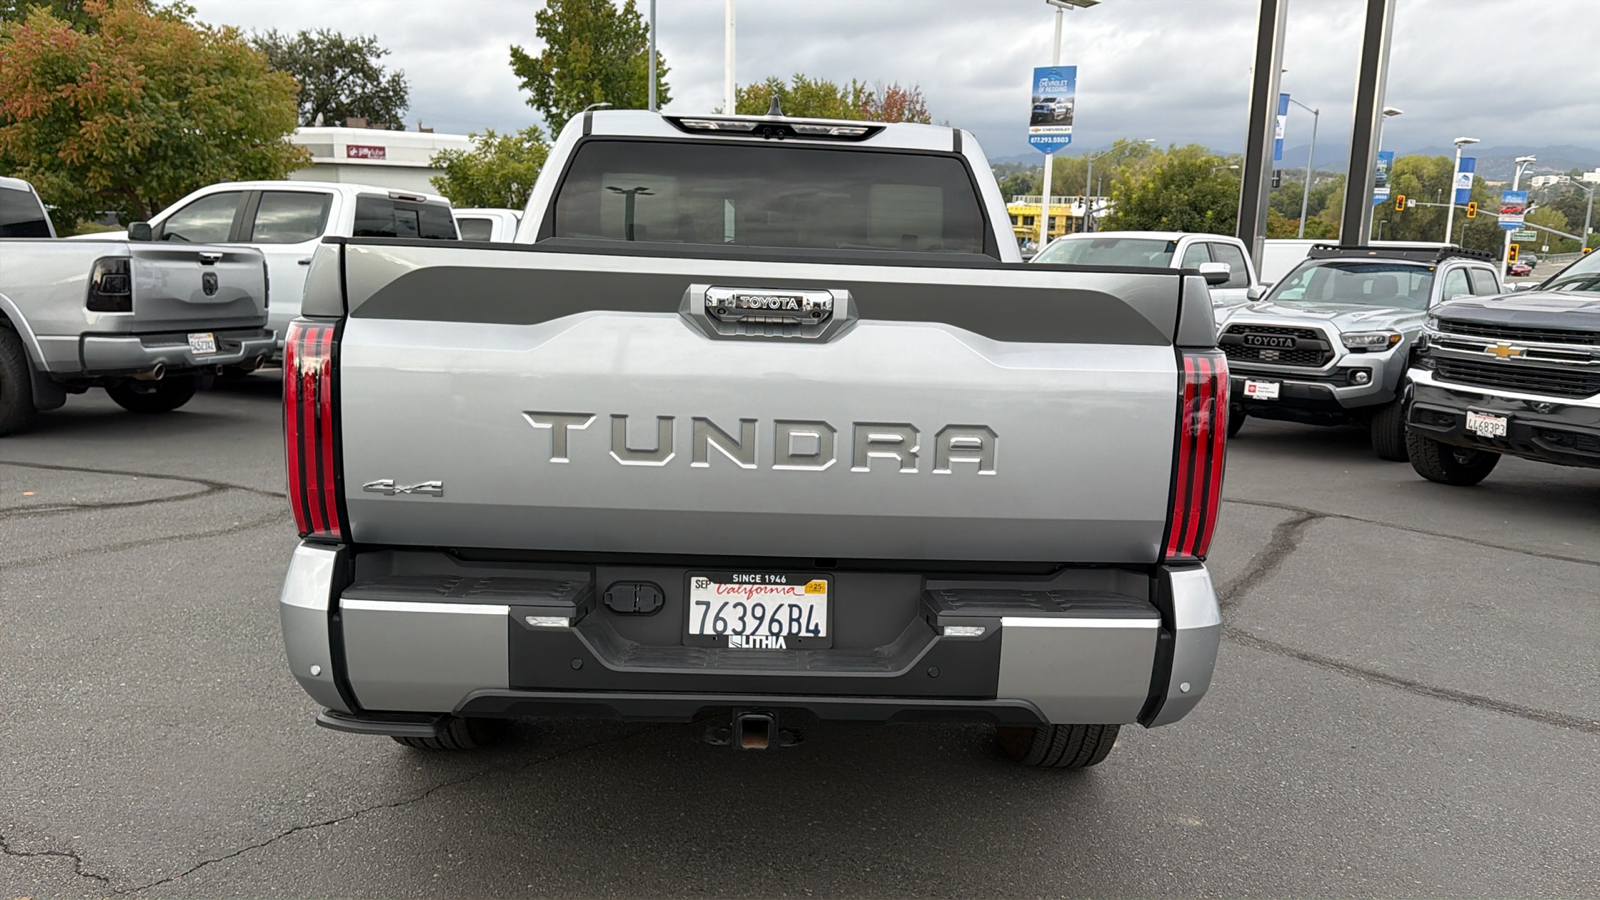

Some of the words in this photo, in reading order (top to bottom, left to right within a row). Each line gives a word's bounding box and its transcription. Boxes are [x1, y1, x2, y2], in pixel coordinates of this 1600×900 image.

[1030, 136, 1069, 144] 877.293.5503
[740, 296, 799, 310] TOYOTA
[1247, 336, 1293, 347] TOYOTA
[522, 410, 998, 475] TUNDRA
[694, 579, 712, 589] SEP
[732, 574, 762, 583] SINCE
[764, 575, 787, 584] 1946
[716, 583, 805, 600] California
[694, 600, 821, 637] 76396B4
[741, 635, 787, 649] LITHIA
